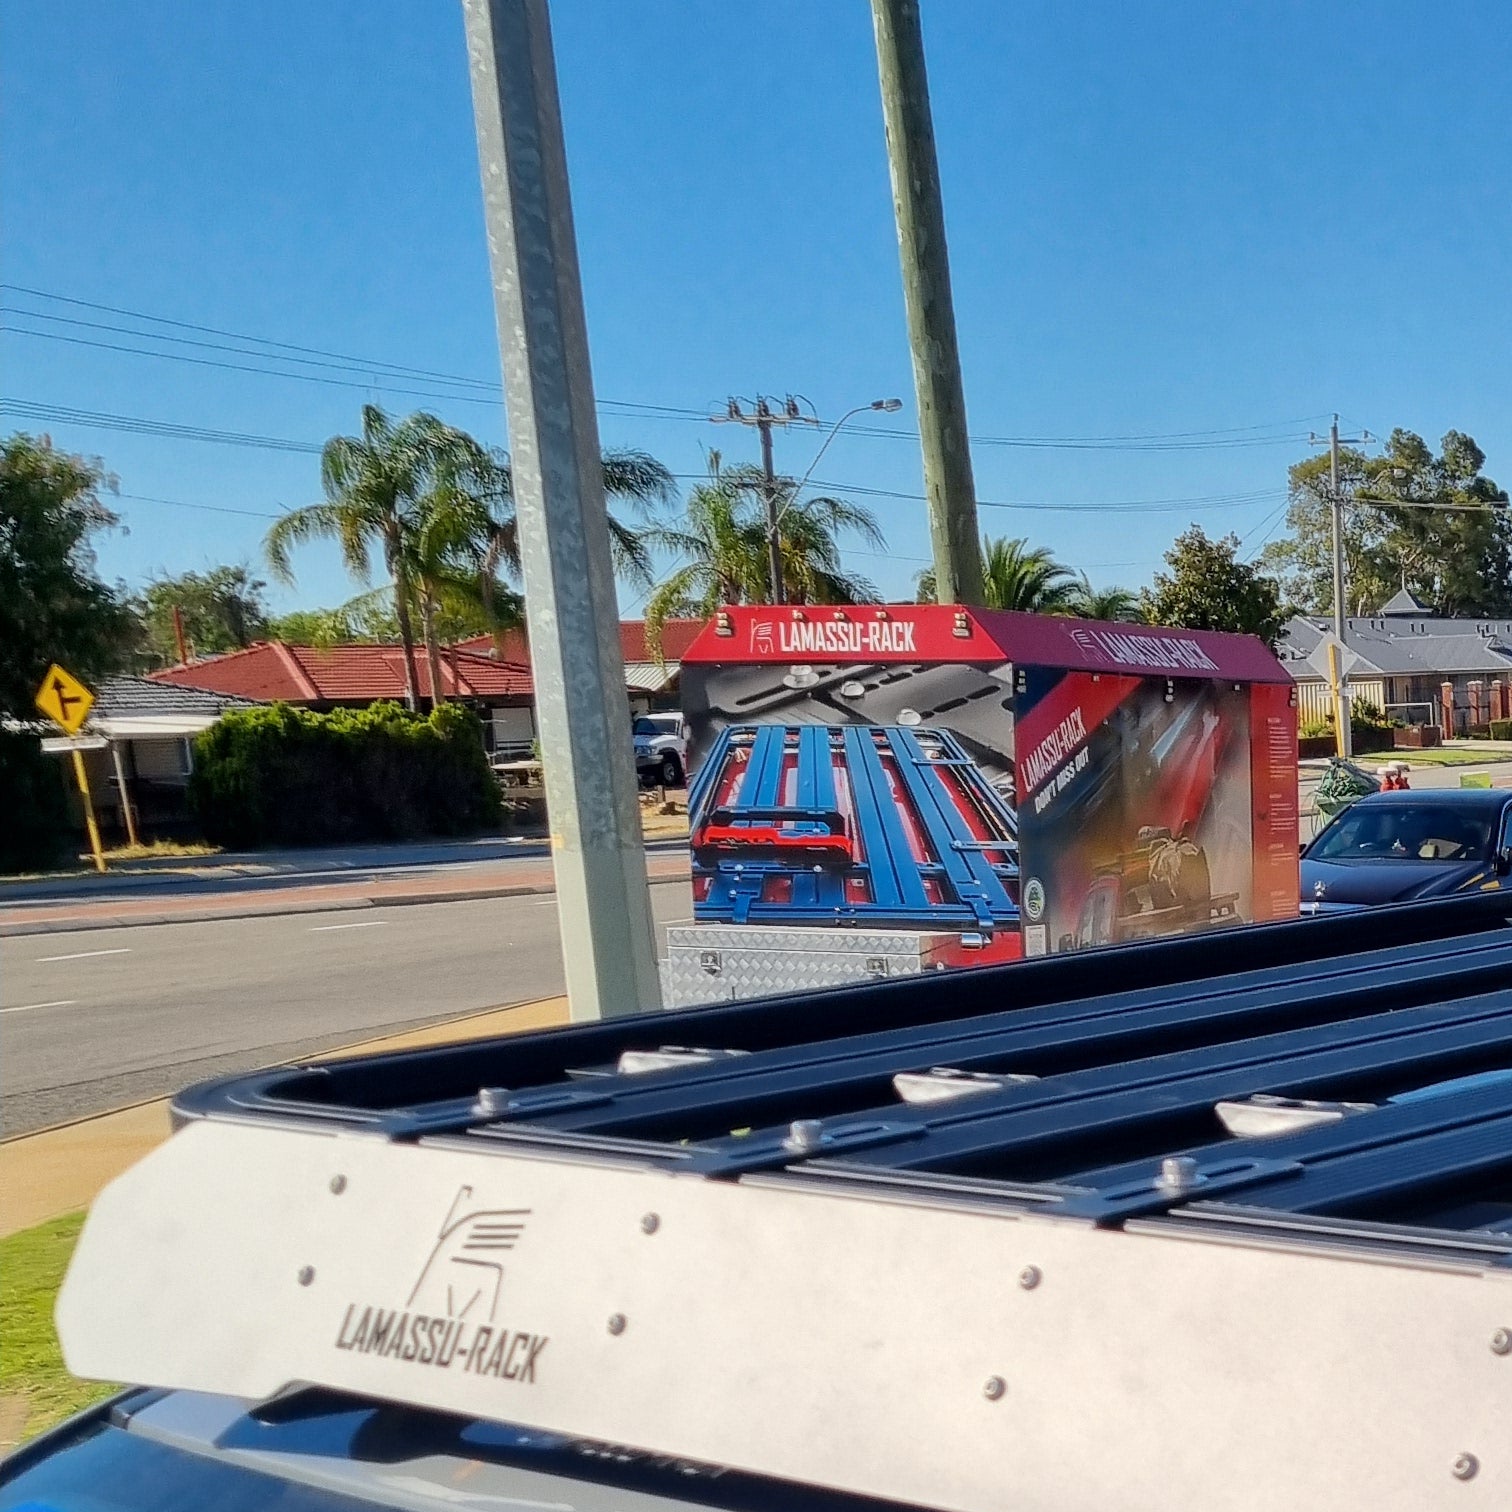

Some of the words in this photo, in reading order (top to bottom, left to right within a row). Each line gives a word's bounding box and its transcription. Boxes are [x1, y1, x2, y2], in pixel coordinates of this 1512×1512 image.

[778, 621, 917, 652] LAMASSU-RACK
[1020, 705, 1087, 793] LAMASSU-RACK
[335, 1302, 551, 1385] LAMASSU-RACK
